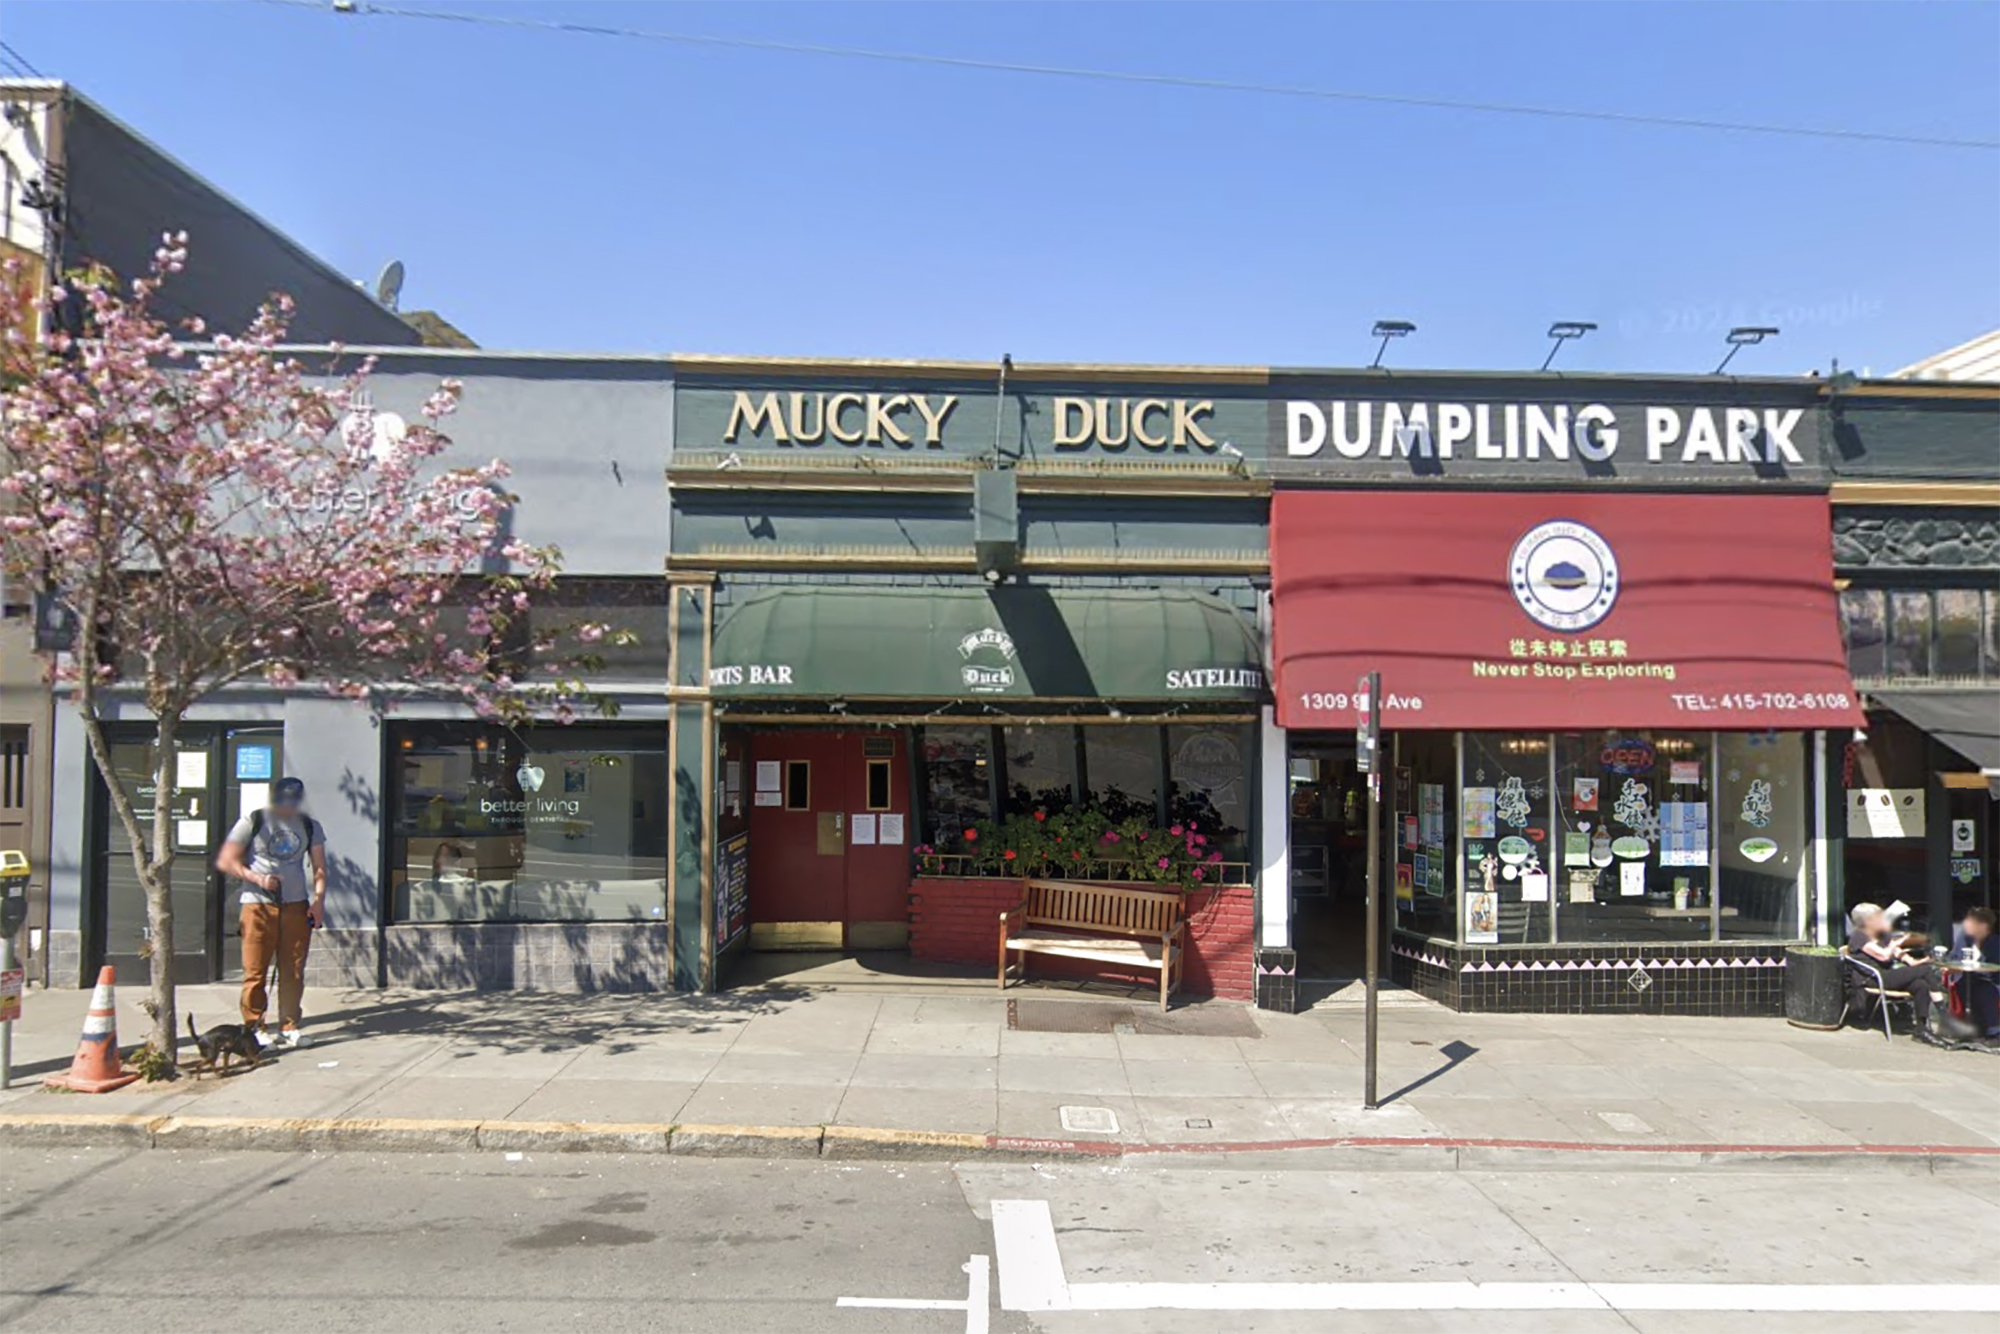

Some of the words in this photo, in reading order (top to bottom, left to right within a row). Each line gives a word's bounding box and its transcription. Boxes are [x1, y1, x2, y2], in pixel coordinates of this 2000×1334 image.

[723, 392, 958, 442] MUCKY
[1053, 397, 1216, 447] DUCK
[1286, 401, 1619, 461] DUMPLING
[1646, 406, 1804, 463] PARK
[749, 664, 793, 684] BAR
[1473, 662, 1528, 677] Never
[1533, 663, 1576, 680] Stop
[1581, 662, 1676, 680] Exploring
[1300, 692, 1349, 710] 1309
[1386, 693, 1423, 710] Ave
[1672, 694, 1717, 711] TEL:
[1721, 692, 1850, 710] 415-702-6108
[1600, 748, 1654, 766] OPEN
[481, 798, 533, 813] better
[537, 798, 579, 816] living
